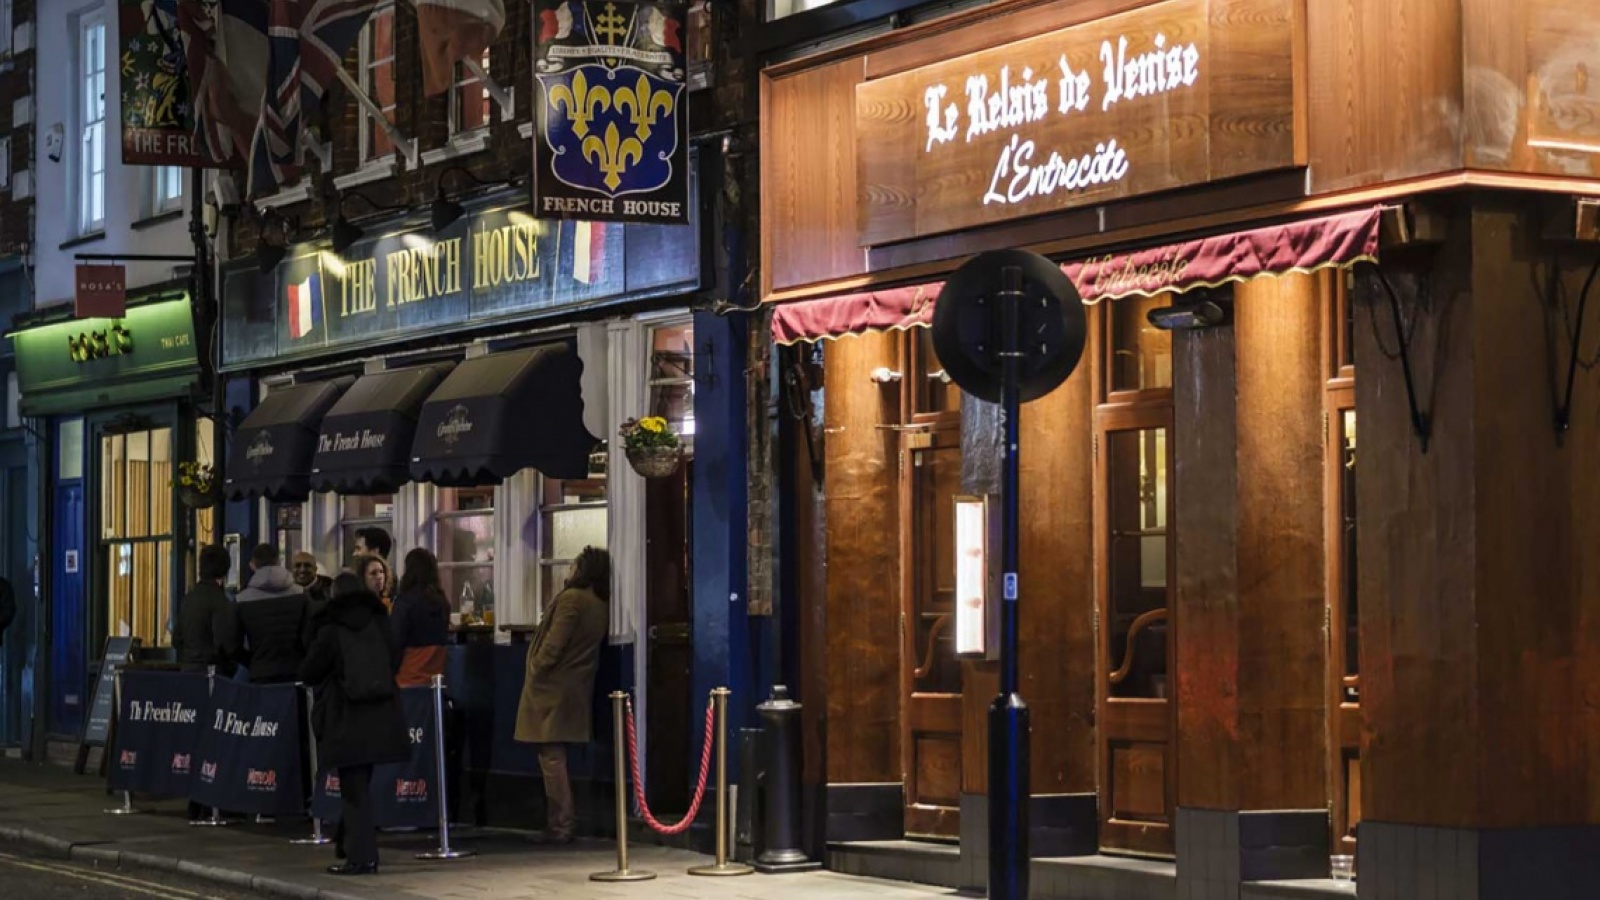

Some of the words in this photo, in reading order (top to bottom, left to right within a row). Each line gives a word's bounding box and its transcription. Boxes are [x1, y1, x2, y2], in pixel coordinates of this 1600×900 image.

[925, 83, 959, 152] Le
[966, 64, 1048, 143] Relais
[1058, 53, 1090, 114] de
[1100, 33, 1199, 111] Venise
[134, 133, 163, 153] THE
[983, 134, 1129, 205] L'Entrecôte
[543, 196, 614, 214] FRENCH
[623, 200, 681, 217] HOUSE
[340, 258, 377, 317] THE
[386, 237, 461, 307] FRENCH
[473, 221, 540, 289] HOUSE
[318, 434, 332, 453] The
[333, 430, 359, 452] French
[361, 429, 386, 449] House
